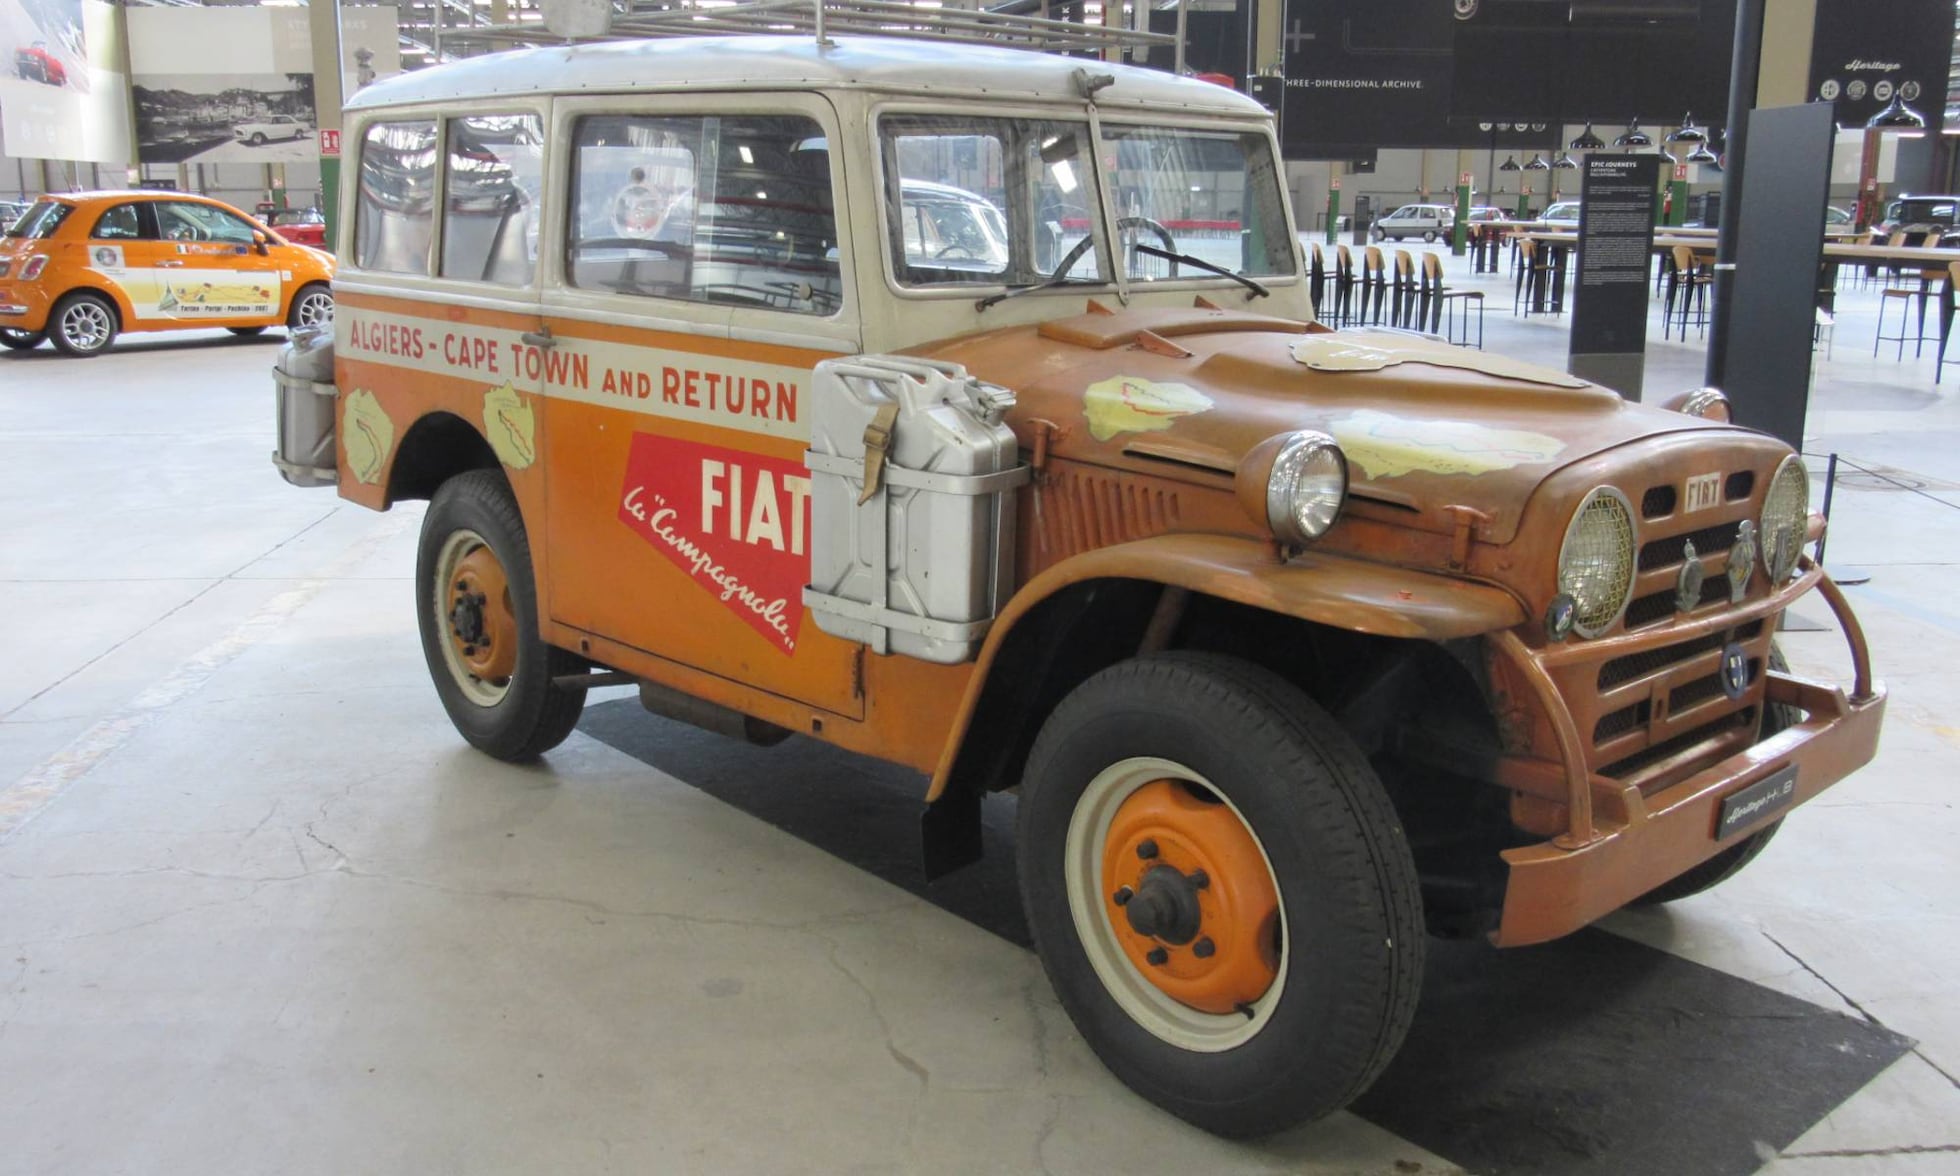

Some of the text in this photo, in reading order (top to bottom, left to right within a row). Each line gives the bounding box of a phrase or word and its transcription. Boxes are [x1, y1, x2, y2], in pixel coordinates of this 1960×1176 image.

[1845, 59, 1901, 72] Heritage
[351, 320, 424, 360] ALGIERS
[444, 333, 499, 373] CAPE
[511, 344, 588, 390] TOWN
[602, 368, 651, 399] AND
[662, 366, 797, 423] RETURN
[702, 458, 812, 556] FIAT
[1687, 479, 1719, 509] FIAT
